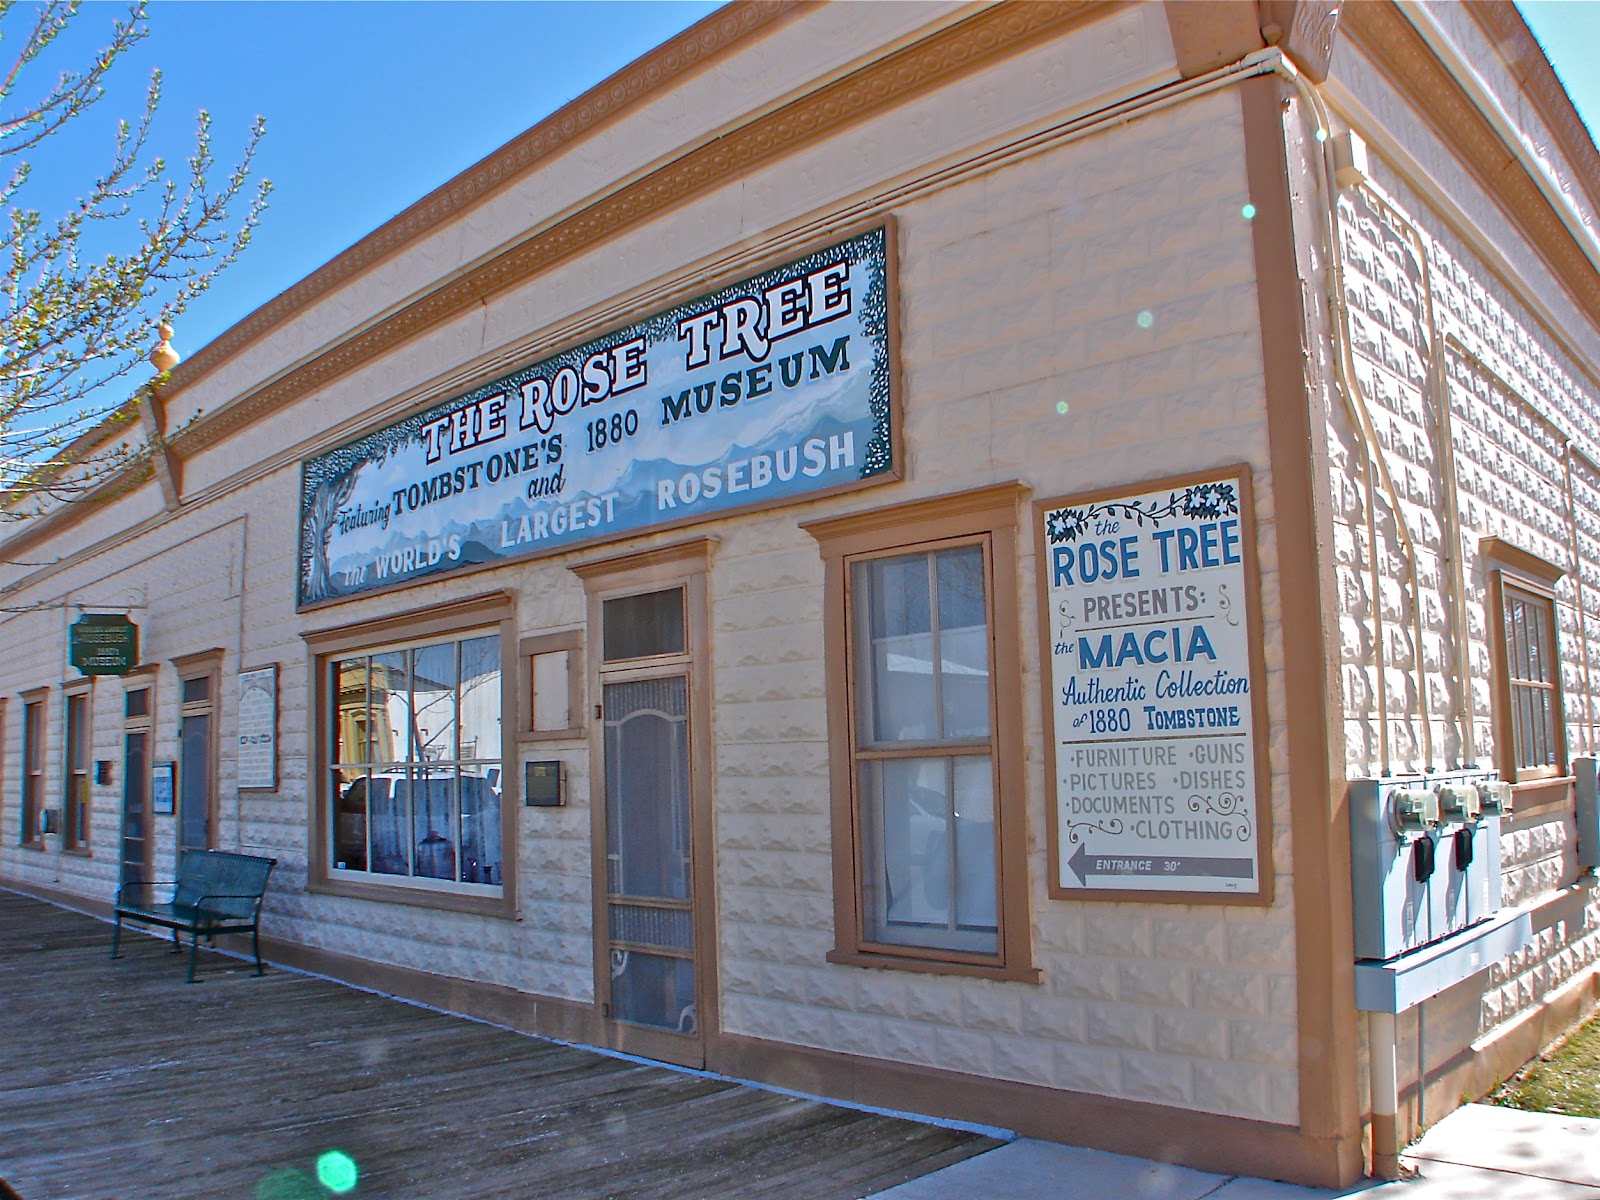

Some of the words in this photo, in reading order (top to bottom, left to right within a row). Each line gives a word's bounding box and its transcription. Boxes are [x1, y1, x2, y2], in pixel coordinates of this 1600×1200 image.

[421, 400, 508, 464] THE
[518, 338, 648, 434] ROSE
[678, 263, 852, 371] TREE
[392, 432, 566, 516] TOMBSTONE'S
[586, 408, 639, 454] 1880
[661, 337, 851, 426] MUSEUM
[528, 463, 566, 500] and
[344, 565, 368, 587] the
[375, 534, 461, 579] WORLD'S
[500, 491, 620, 549] LARGEST
[657, 431, 856, 511] ROSEBUSH
[1095, 519, 1120, 536] the
[1053, 535, 1140, 587] ROSE
[1152, 519, 1241, 573] TREE
[1083, 585, 1206, 622] PRESENTS:
[81, 656, 127, 666] MUSEUM
[1054, 642, 1074, 655] the
[1078, 625, 1217, 670] MACIA
[1062, 676, 1146, 706] Authentic
[1156, 670, 1249, 699] Collection
[1073, 713, 1087, 728] of
[1090, 708, 1130, 734] 1880
[1143, 706, 1240, 730] TOMBSTONE
[1096, 860, 1152, 871] ENTRANCE
